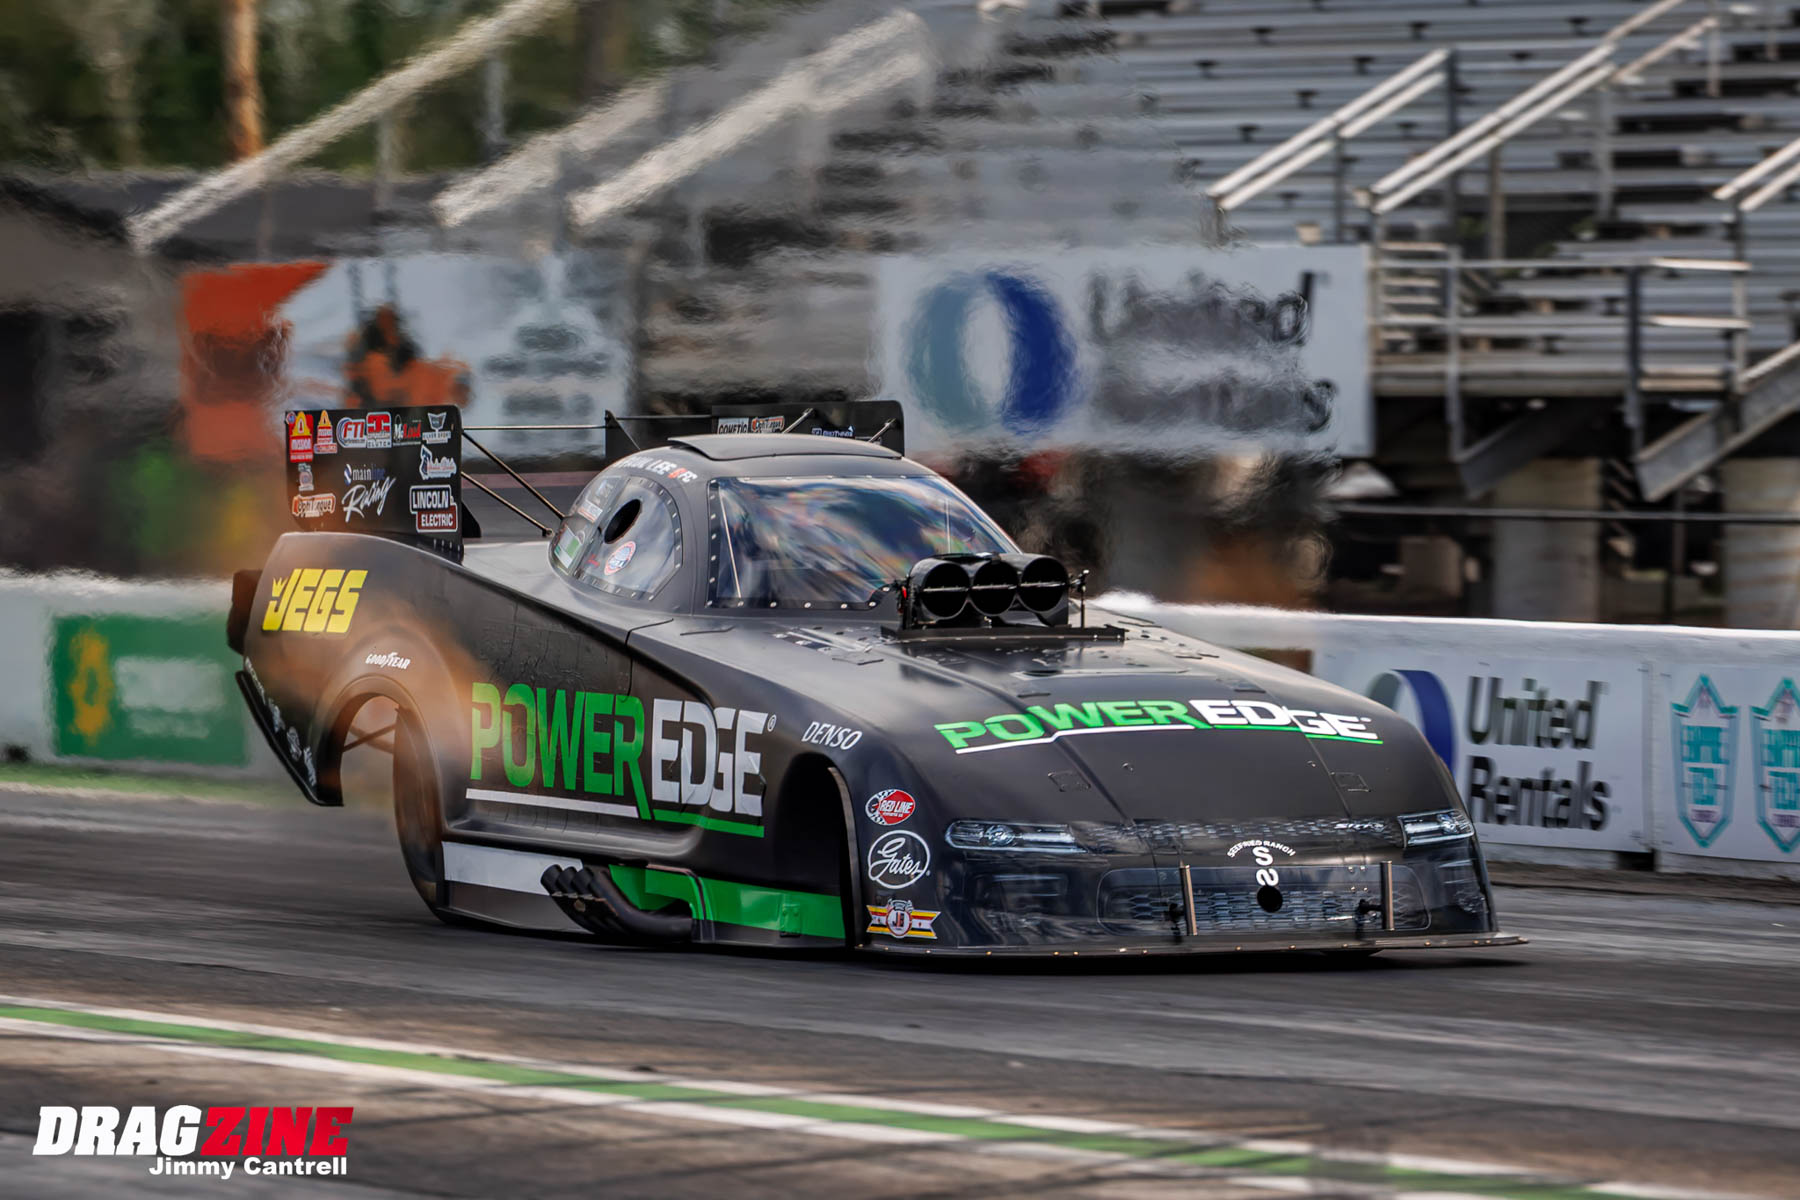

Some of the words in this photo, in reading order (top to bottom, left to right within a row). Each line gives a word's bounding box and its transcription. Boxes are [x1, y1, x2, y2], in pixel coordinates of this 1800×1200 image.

[343, 421, 365, 439] FTI
[341, 477, 396, 523] Racing
[412, 490, 449, 509] LINCOLN
[421, 513, 454, 528] ELECTRIC
[262, 568, 368, 633] JEGS
[365, 652, 411, 670] GOODYEAR
[1466, 676, 1604, 749] United
[801, 721, 863, 750] DENSO
[879, 800, 895, 812] RED
[893, 800, 913, 814] LINE
[1467, 755, 1611, 831] Rentals
[869, 837, 922, 880] Gates
